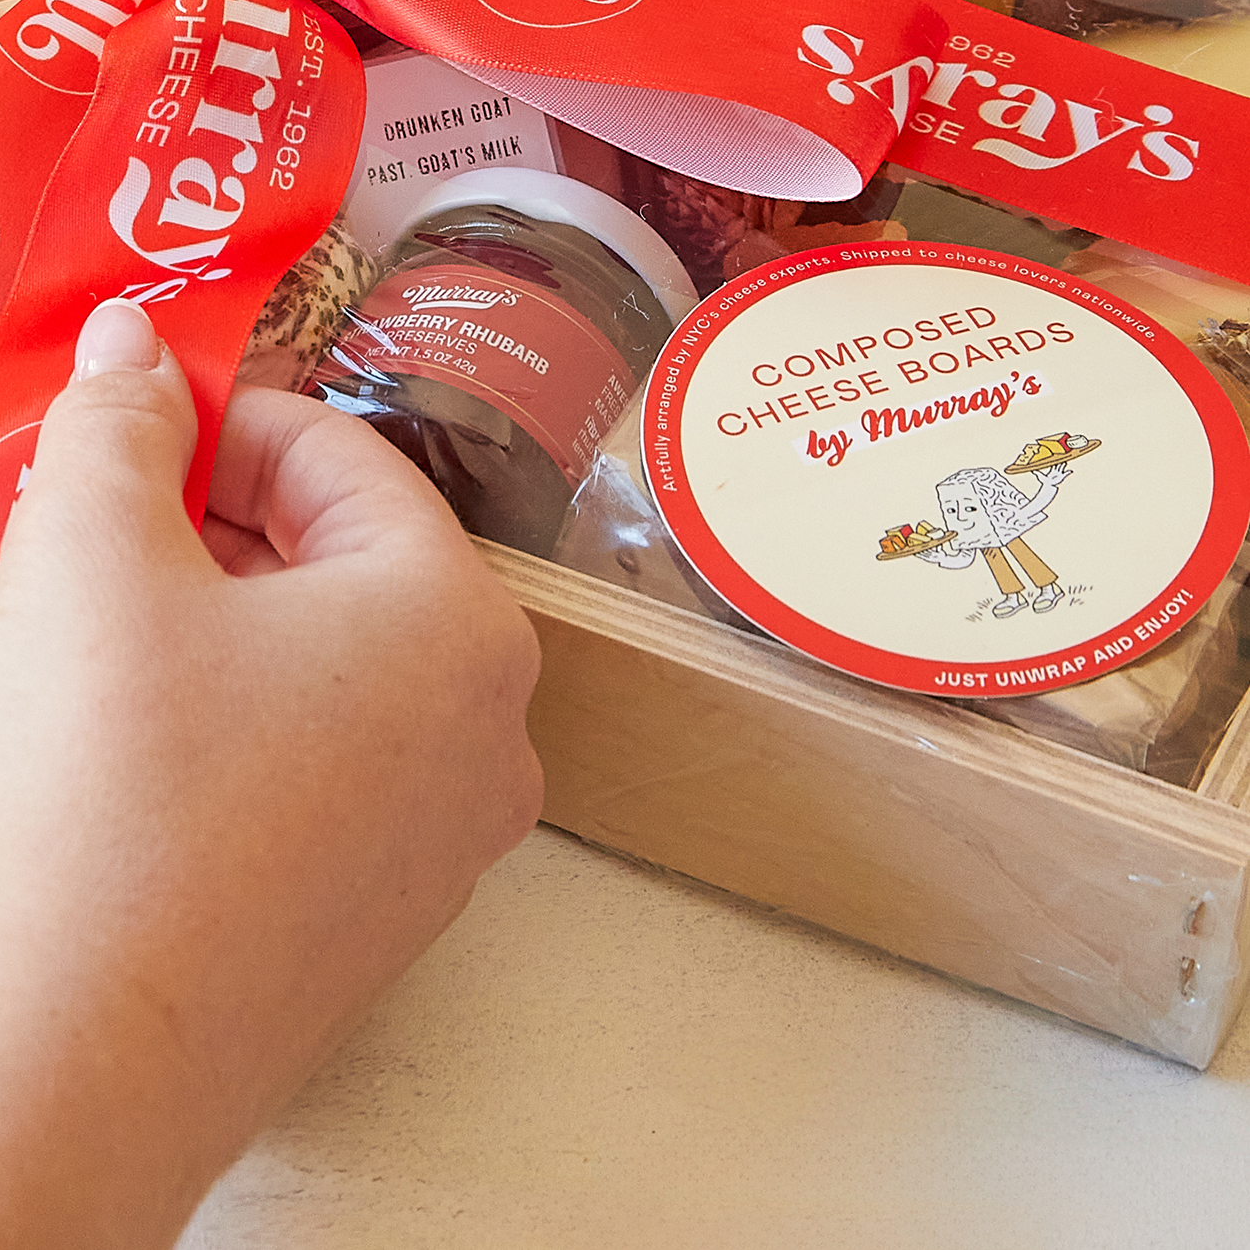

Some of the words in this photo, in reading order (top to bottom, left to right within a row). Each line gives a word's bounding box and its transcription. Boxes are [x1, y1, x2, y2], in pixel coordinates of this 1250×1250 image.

[297, 11, 325, 87] EST.
[945, 35, 1017, 69] 962
[384, 105, 465, 141] DRUNKEN
[470, 97, 513, 122] GOAT
[923, 55, 1200, 183] ray's
[269, 100, 312, 191] 1962
[367, 161, 413, 186] PAST.
[418, 146, 476, 176] GOAT'S
[481, 135, 523, 161] MILK
[769, 256, 836, 282] experts.
[840, 248, 912, 261] Shipped
[919, 249, 938, 258] to
[945, 251, 1007, 270] cheese
[402, 284, 523, 312] Murray's
[719, 277, 767, 311] cheese
[1013, 263, 1067, 289] lovers
[682, 310, 720, 347] NYC's
[1071, 286, 1156, 342] nationwide.
[387, 330, 479, 356] PRESERVES
[413, 347, 432, 360] 1.5
[434, 351, 453, 365] OZ
[453, 358, 478, 376] 42g
[459, 320, 551, 376] RHUBARB
[671, 348, 692, 365] by
[751, 306, 997, 388] COMPOSED
[657, 365, 680, 431] arranged
[716, 370, 890, 438] CHEESE
[897, 321, 1075, 385] BOARDS
[806, 429, 853, 468] by
[861, 370, 1042, 443] Murray's
[654, 434, 678, 492] Artfully
[934, 670, 988, 688] JUST
[995, 655, 1087, 688] UNWRAP
[1092, 635, 1134, 665] AND
[1134, 588, 1195, 642] ENJOY!
